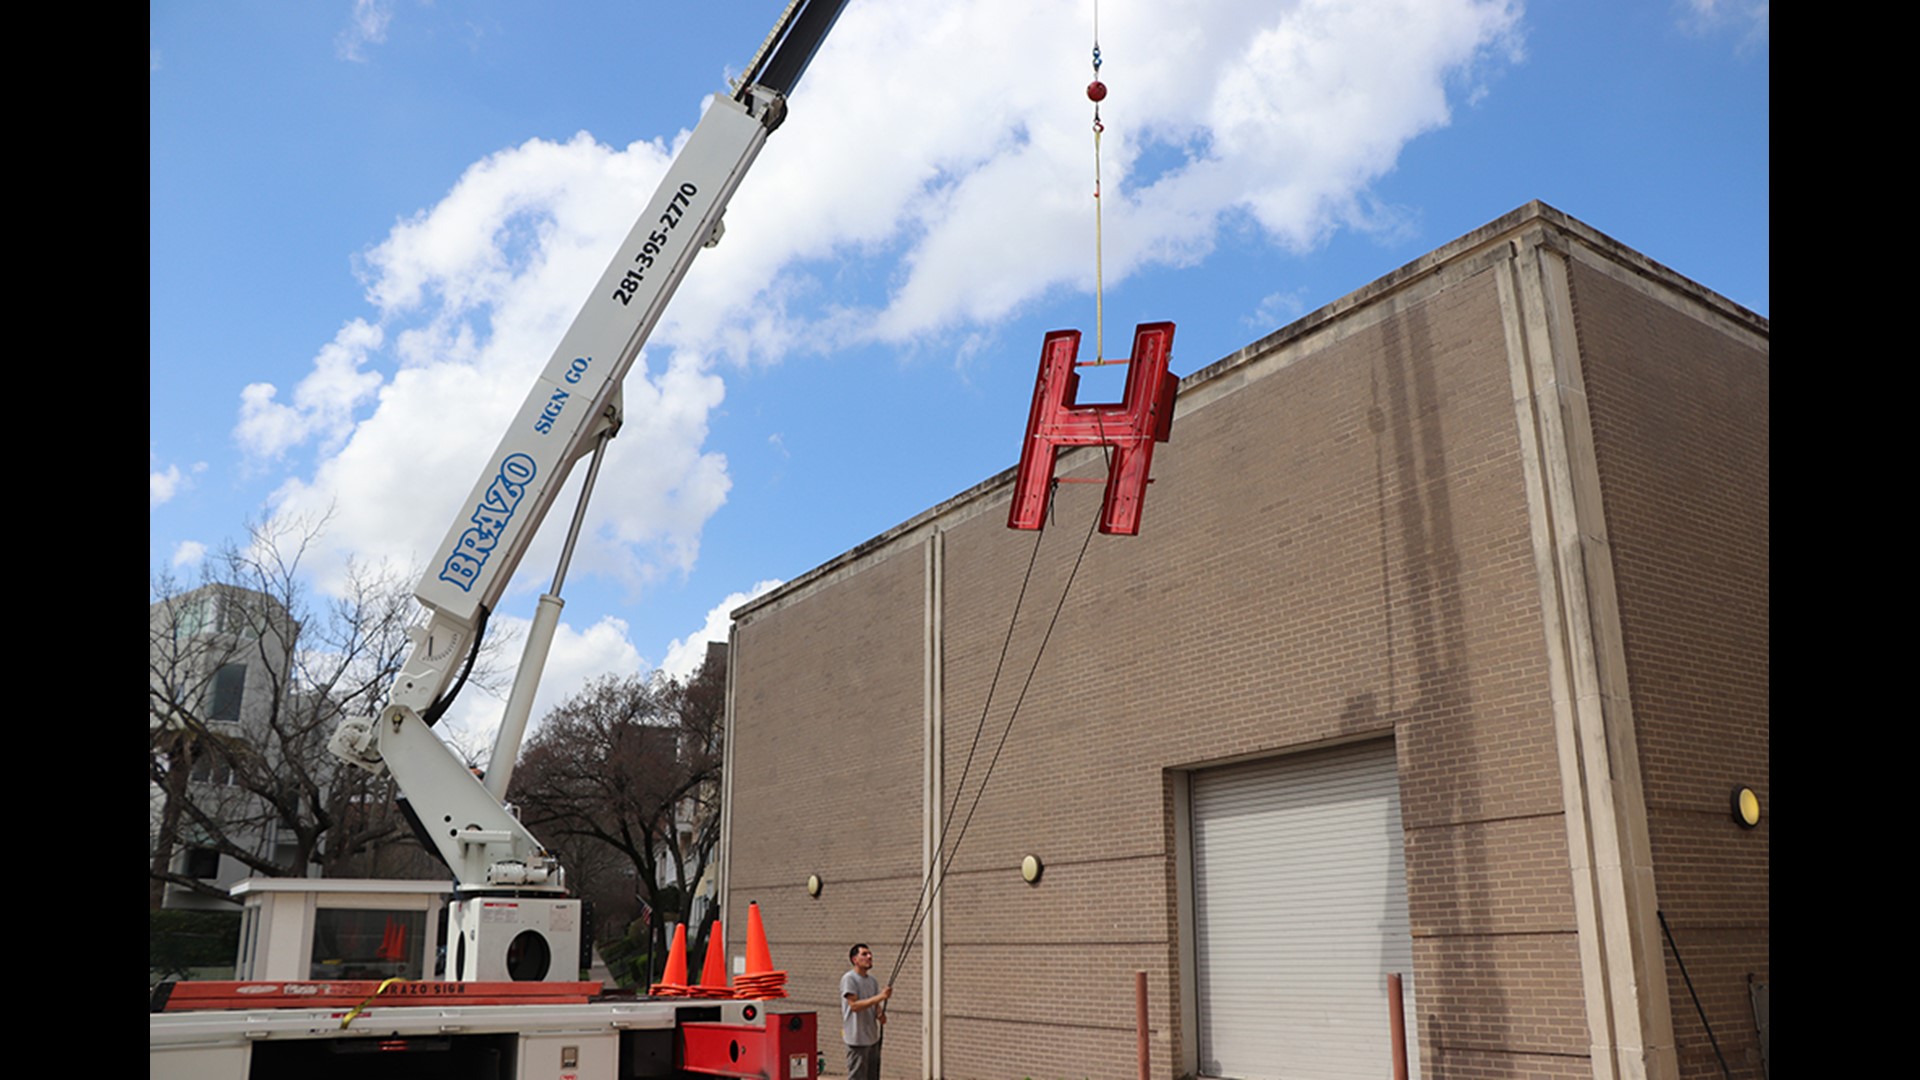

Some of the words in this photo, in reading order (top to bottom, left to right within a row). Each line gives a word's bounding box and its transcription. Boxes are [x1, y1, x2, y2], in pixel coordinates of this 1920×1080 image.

[612, 182, 697, 306] 281-395-2770
[534, 387, 570, 435] SIGN
[564, 356, 592, 384] CO.
[1007, 321, 1176, 536] H
[439, 453, 537, 592] BRAZO
[434, 984, 465, 993] SIGN
